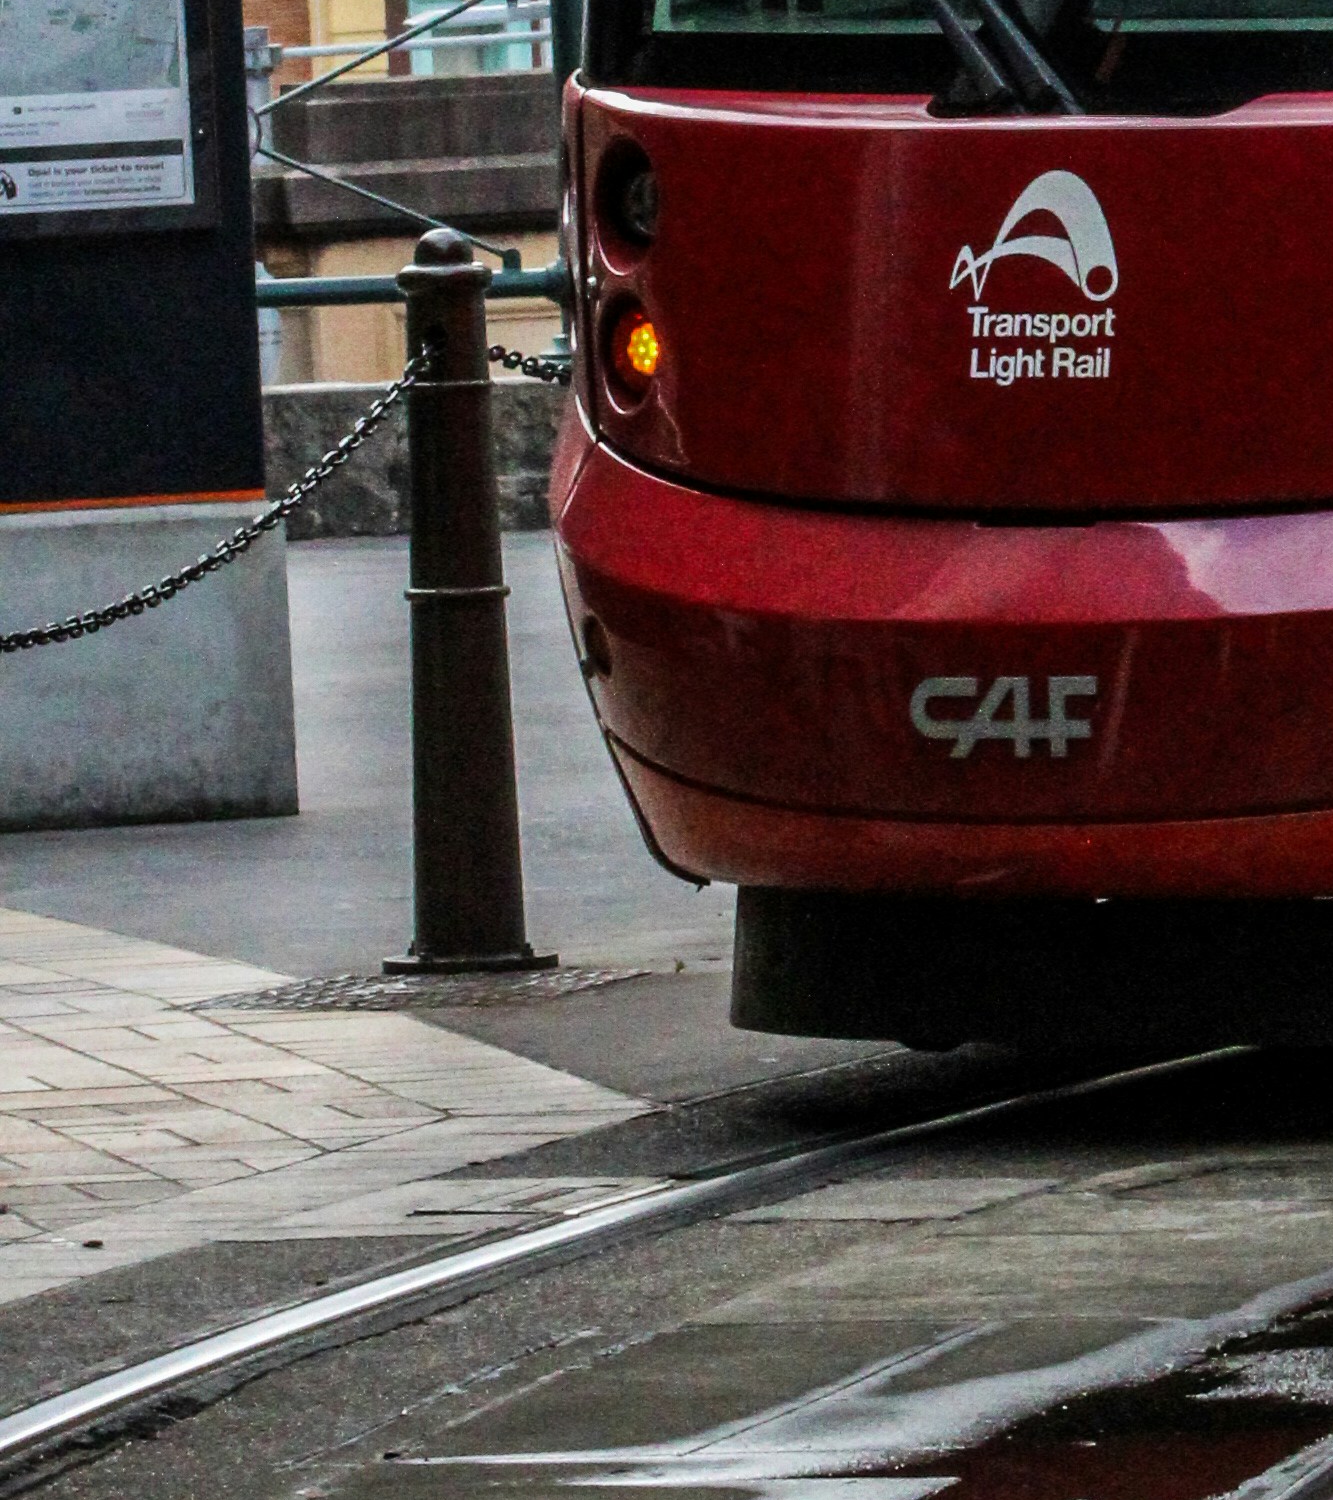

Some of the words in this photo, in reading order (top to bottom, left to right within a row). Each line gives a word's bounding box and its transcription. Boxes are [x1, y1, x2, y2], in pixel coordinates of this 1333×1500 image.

[967, 306, 1116, 344] Transport
[970, 348, 1045, 386] Light
[1051, 347, 1111, 378] Rail
[908, 674, 1098, 758] CAF
